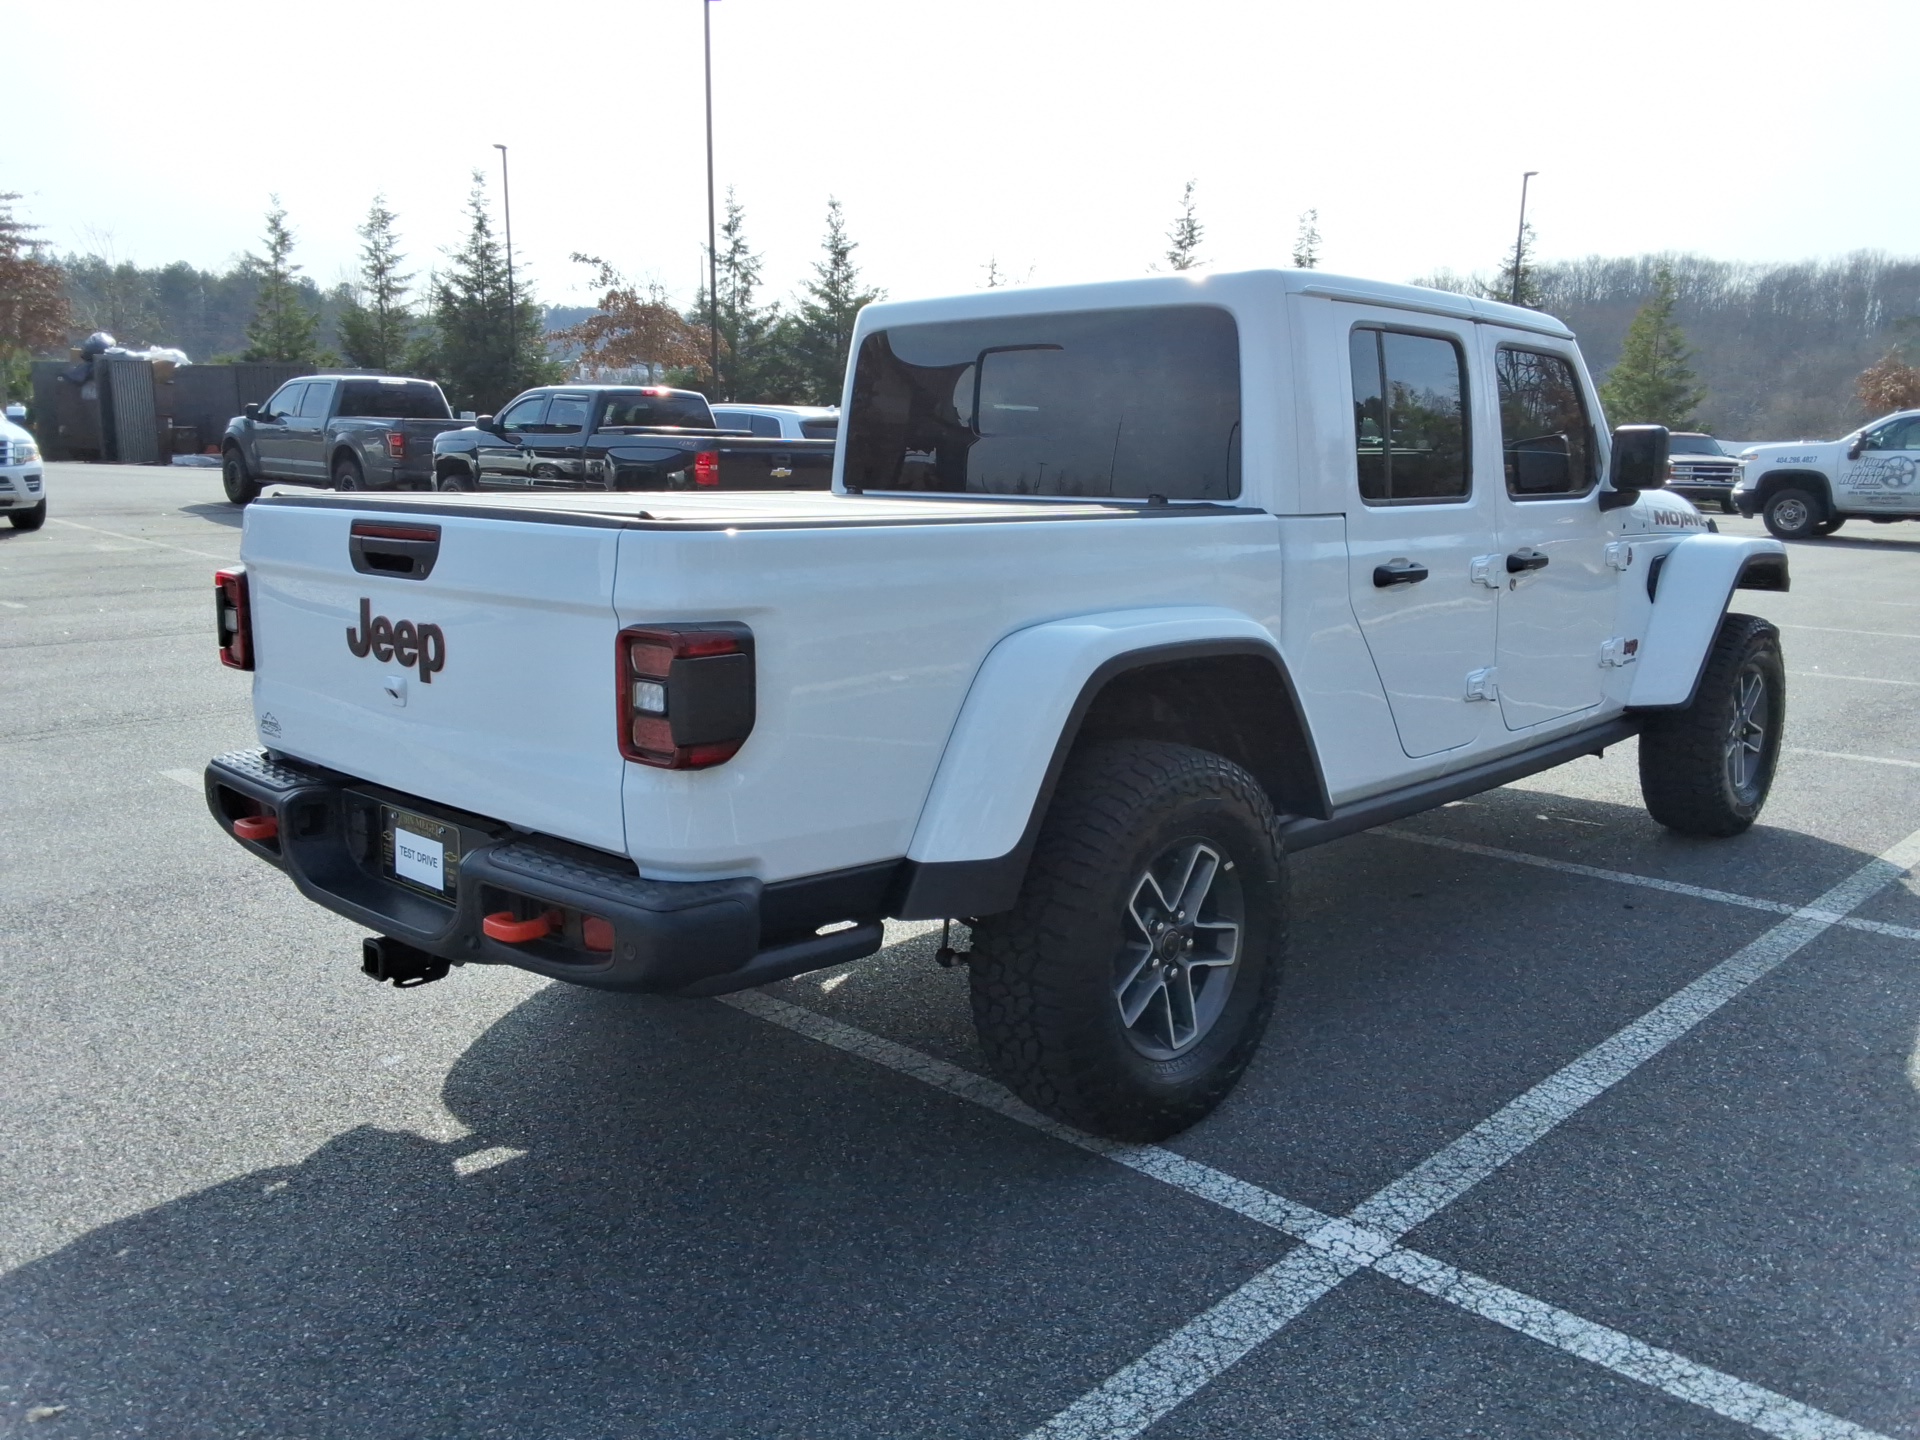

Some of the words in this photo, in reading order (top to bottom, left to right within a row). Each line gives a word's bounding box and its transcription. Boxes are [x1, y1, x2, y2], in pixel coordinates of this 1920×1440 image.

[1852, 465, 1888, 476] Wheel
[1858, 456, 1887, 468] Alloy
[1839, 473, 1884, 489] Repair
[1653, 510, 1706, 528] MOJAVE
[346, 597, 446, 684] Jeep
[399, 845, 416, 860] TEST
[417, 851, 438, 869] DRIVE
